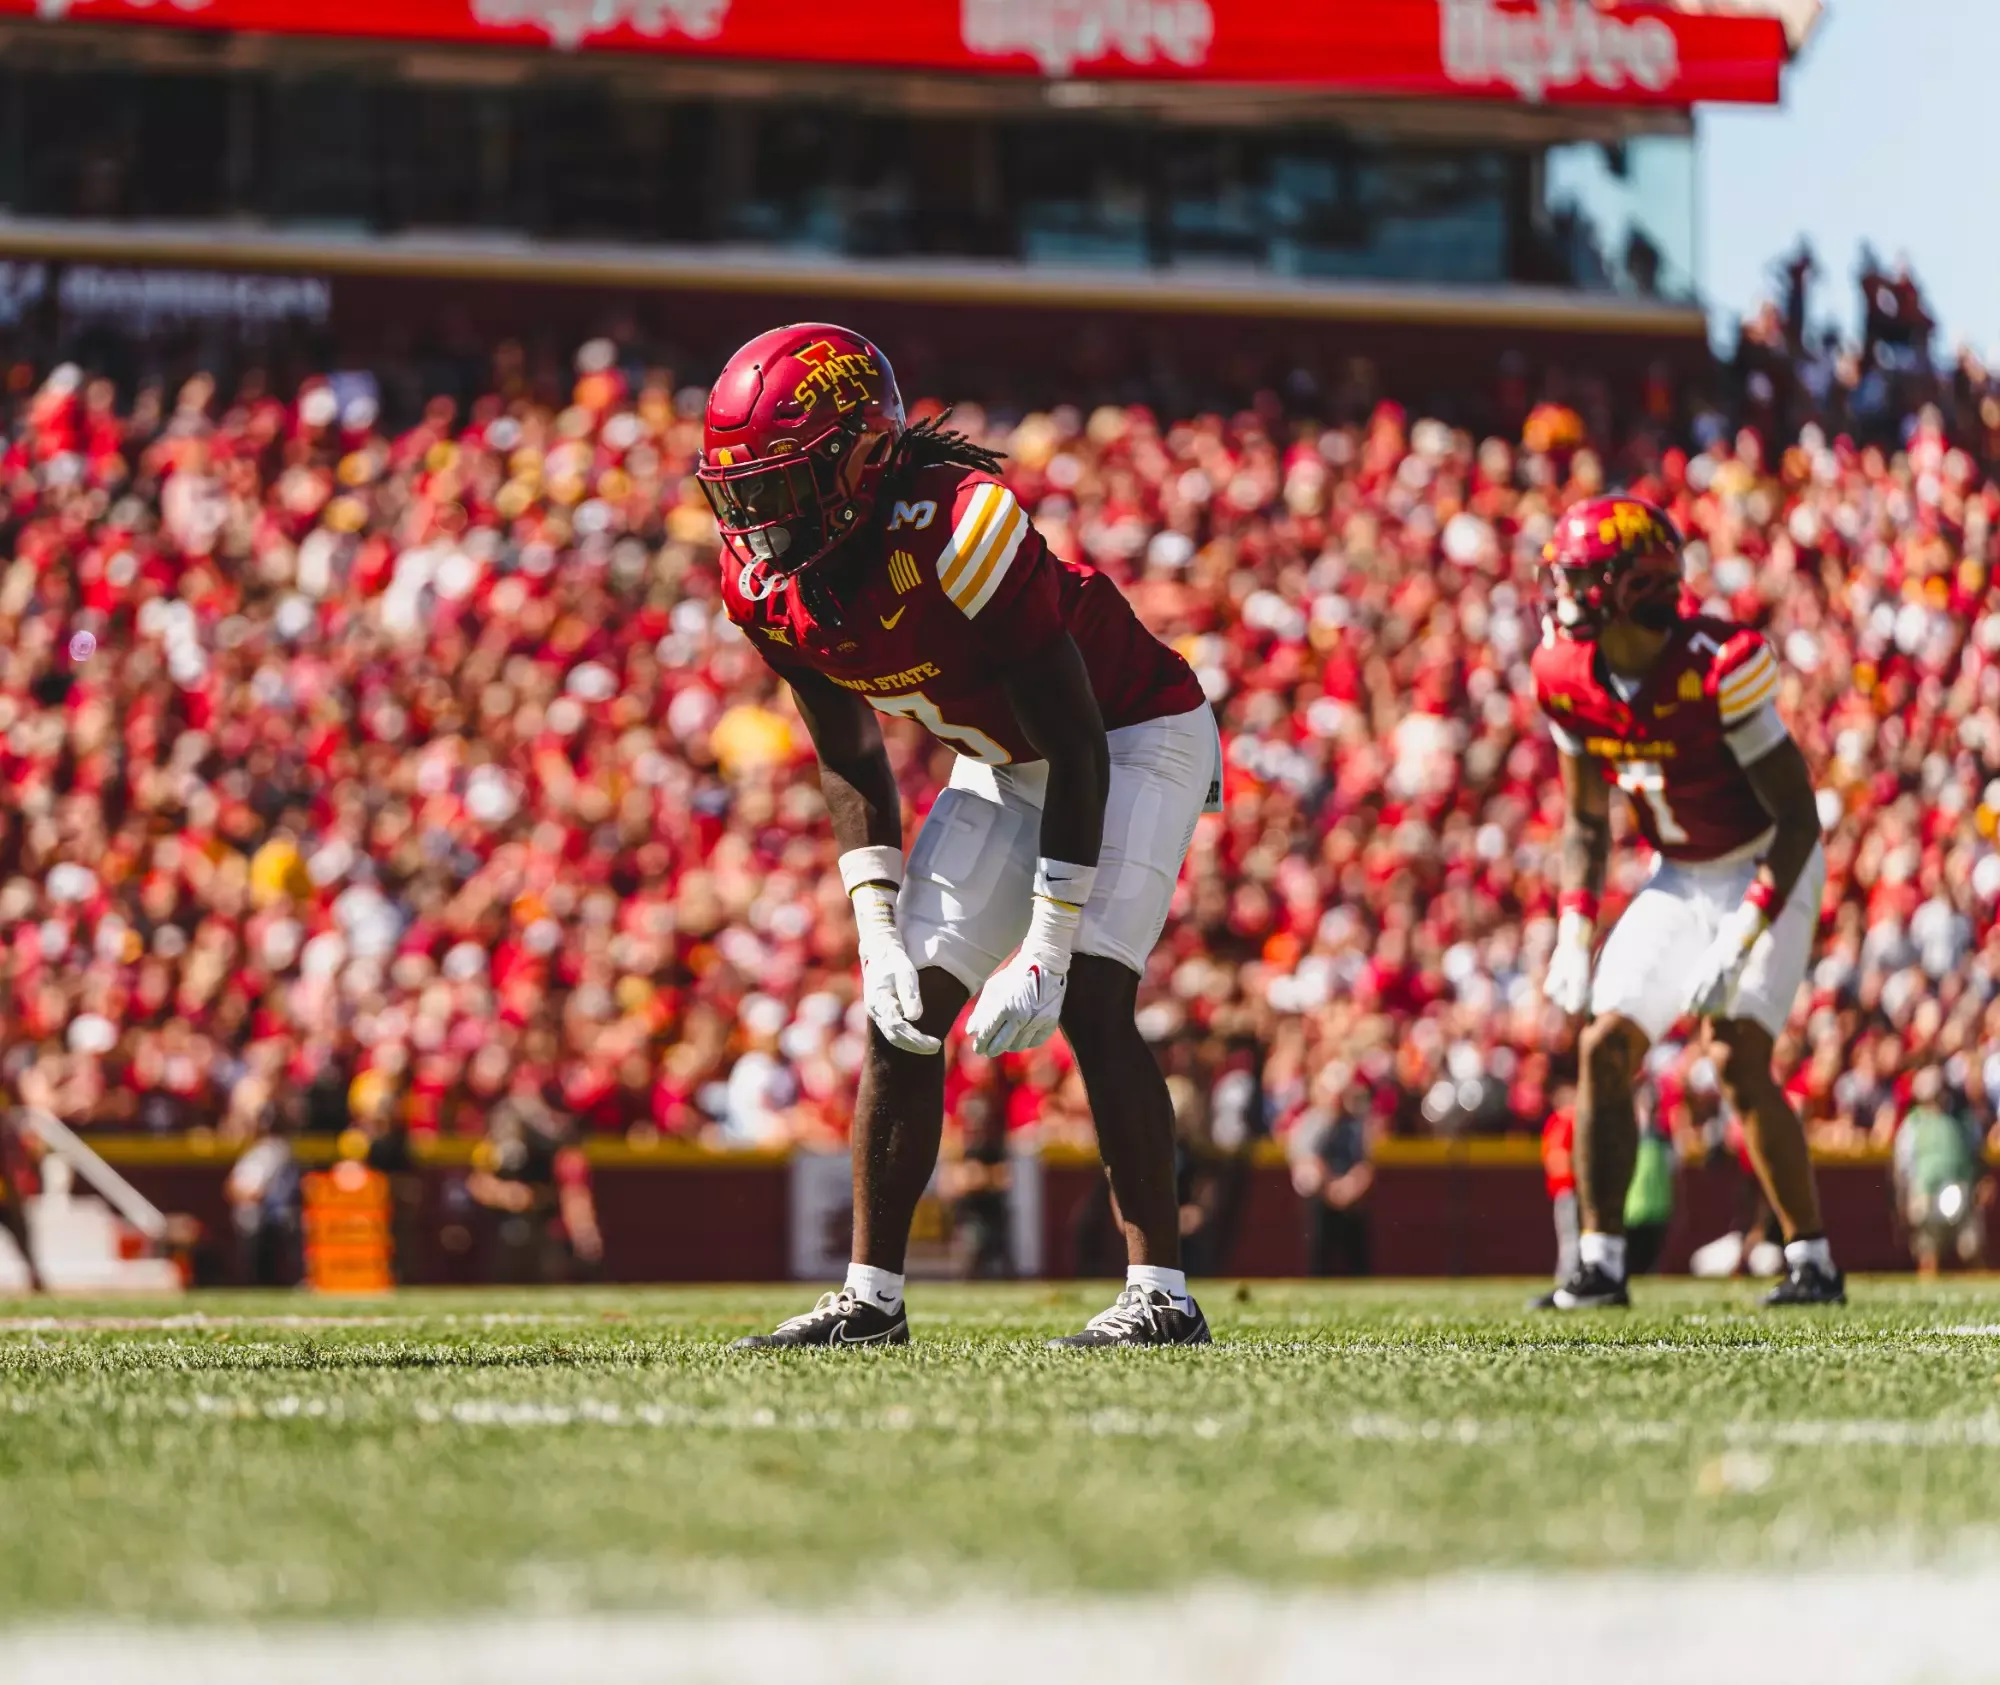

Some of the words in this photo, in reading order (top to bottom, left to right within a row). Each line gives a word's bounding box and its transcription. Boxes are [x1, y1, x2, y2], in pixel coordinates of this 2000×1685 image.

[795, 354, 878, 411] STATE
[887, 500, 938, 530] 3
[873, 661, 941, 691] STATE
